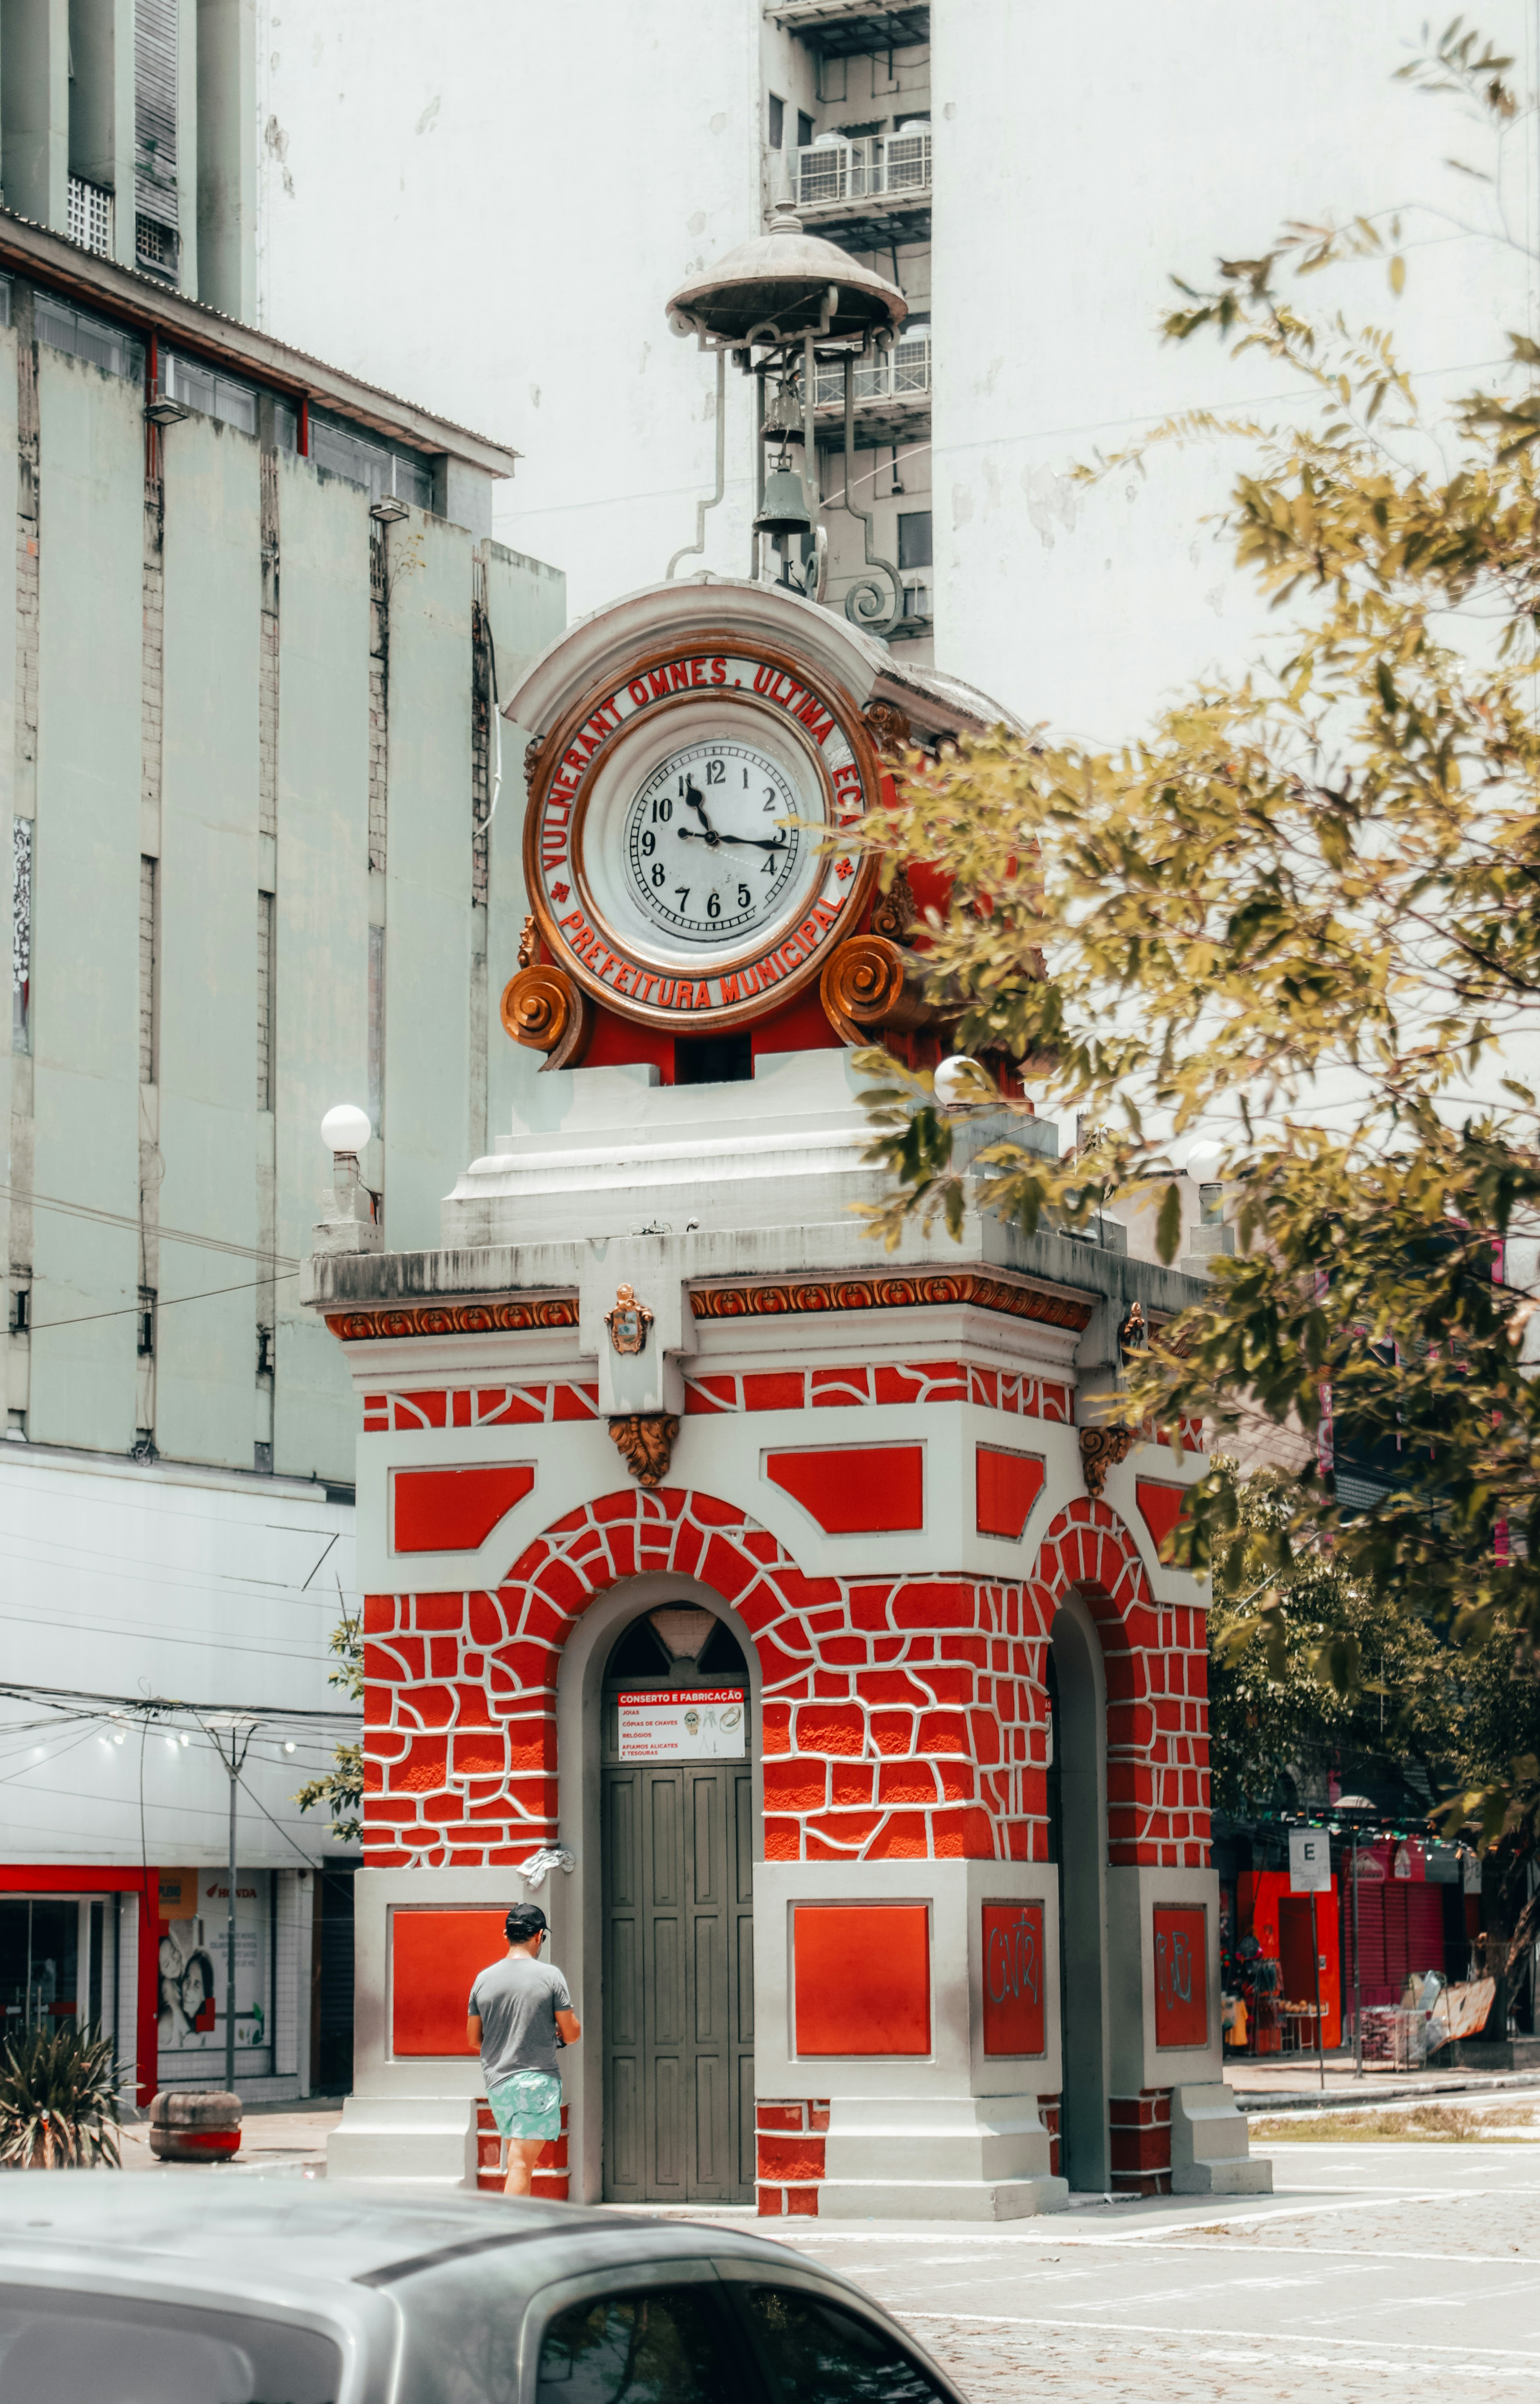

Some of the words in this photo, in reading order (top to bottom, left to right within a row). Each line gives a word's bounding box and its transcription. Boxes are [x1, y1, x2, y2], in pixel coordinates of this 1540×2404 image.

[543, 696, 623, 872] VULNERANT
[628, 658, 741, 706] OMNES,
[753, 665, 835, 746] ULTIMA
[706, 760, 725, 785] 12
[743, 768, 749, 789] 1
[652, 799, 672, 823] 10
[762, 787, 776, 811] 2
[642, 831, 656, 856] 9
[652, 863, 665, 886] 8
[760, 854, 777, 875] 4
[675, 888, 690, 912] 7
[707, 893, 721, 918] 6
[738, 885, 751, 907] 5
[559, 910, 710, 1009] PREFEITURA
[720, 896, 846, 1005] MUNICIPAL
[620, 1693, 670, 1703] CONSERTO
[680, 1690, 742, 1701] FABRICAÇÃO
[1304, 1843, 1315, 1861] E
[218, 1888, 257, 1898] HNDA
